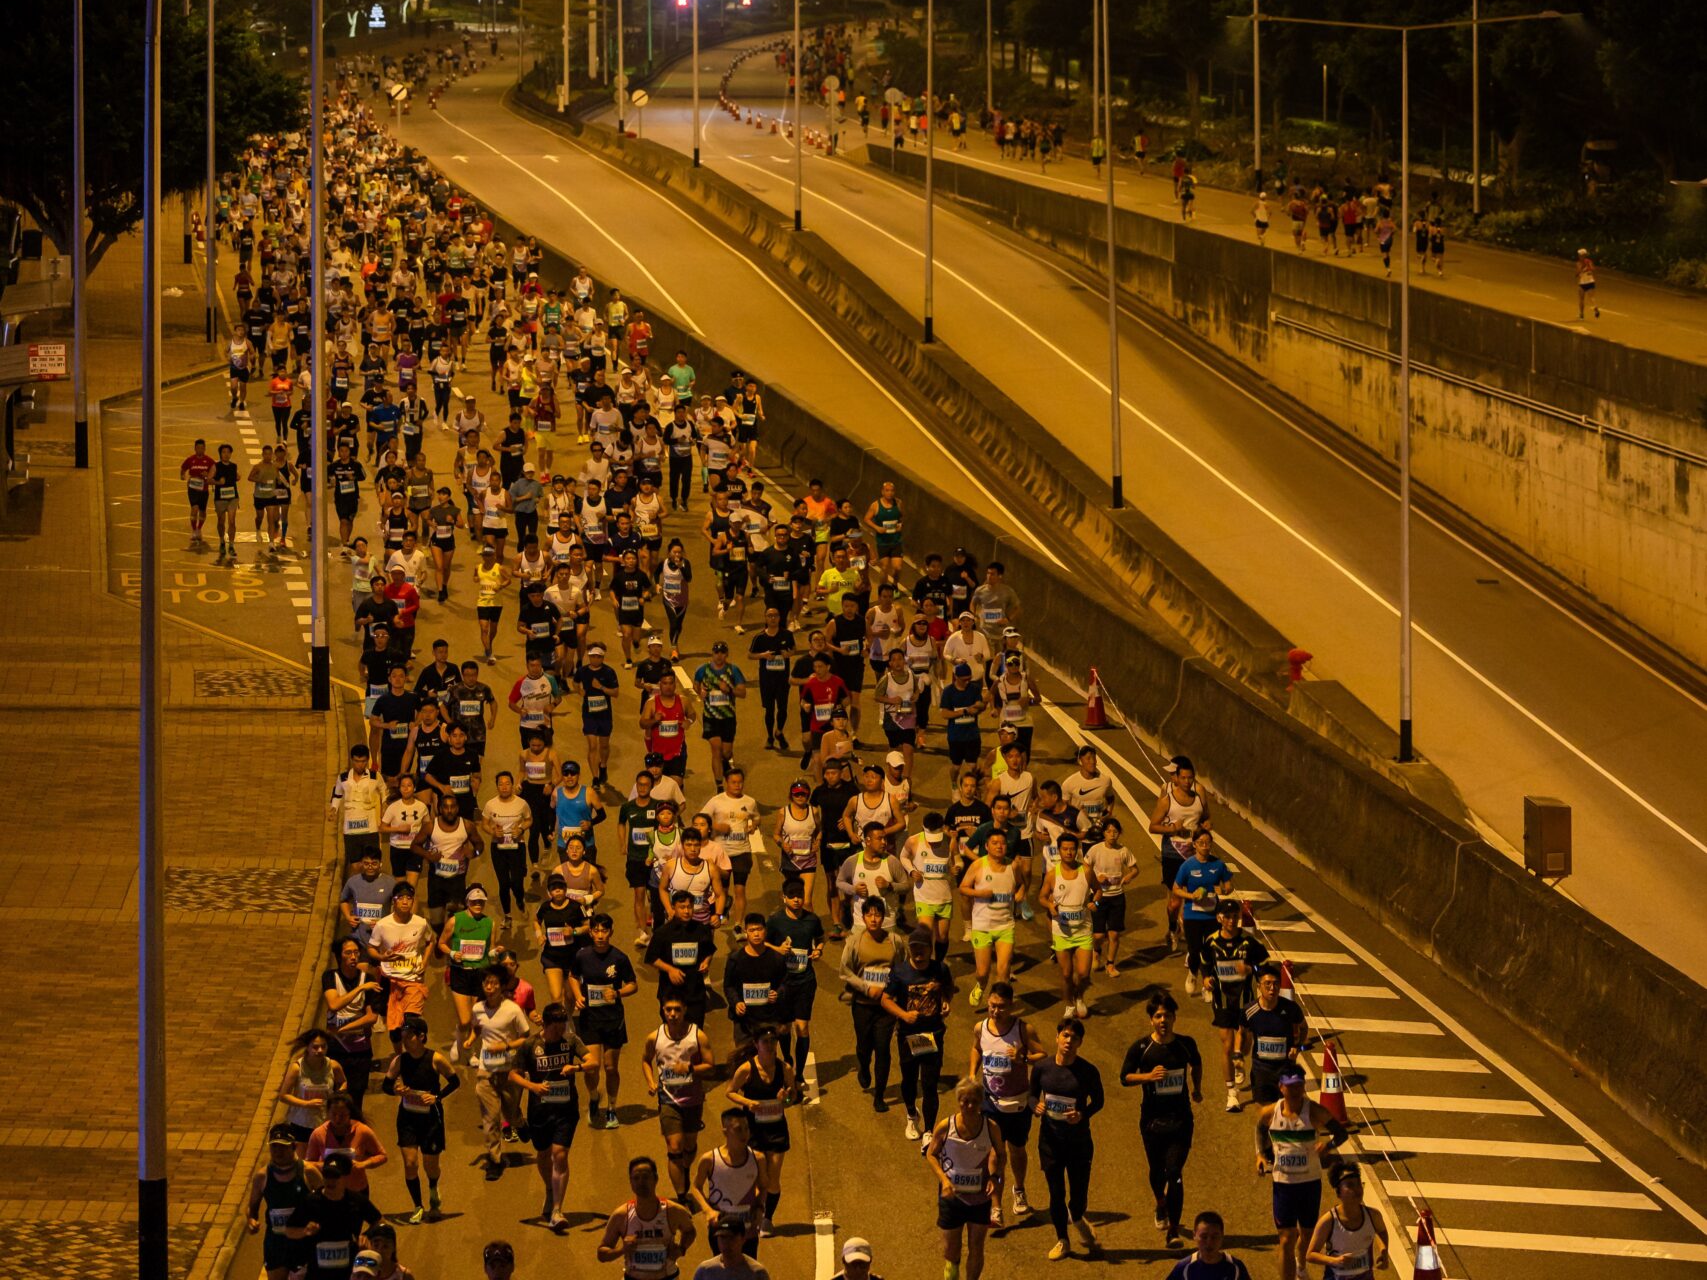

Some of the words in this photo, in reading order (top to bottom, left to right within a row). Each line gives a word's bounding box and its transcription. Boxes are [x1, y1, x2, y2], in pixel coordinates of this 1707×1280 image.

[955, 816, 981, 825] SPORTS
[359, 908, 380, 918] B2320
[675, 949, 696, 957] B3007
